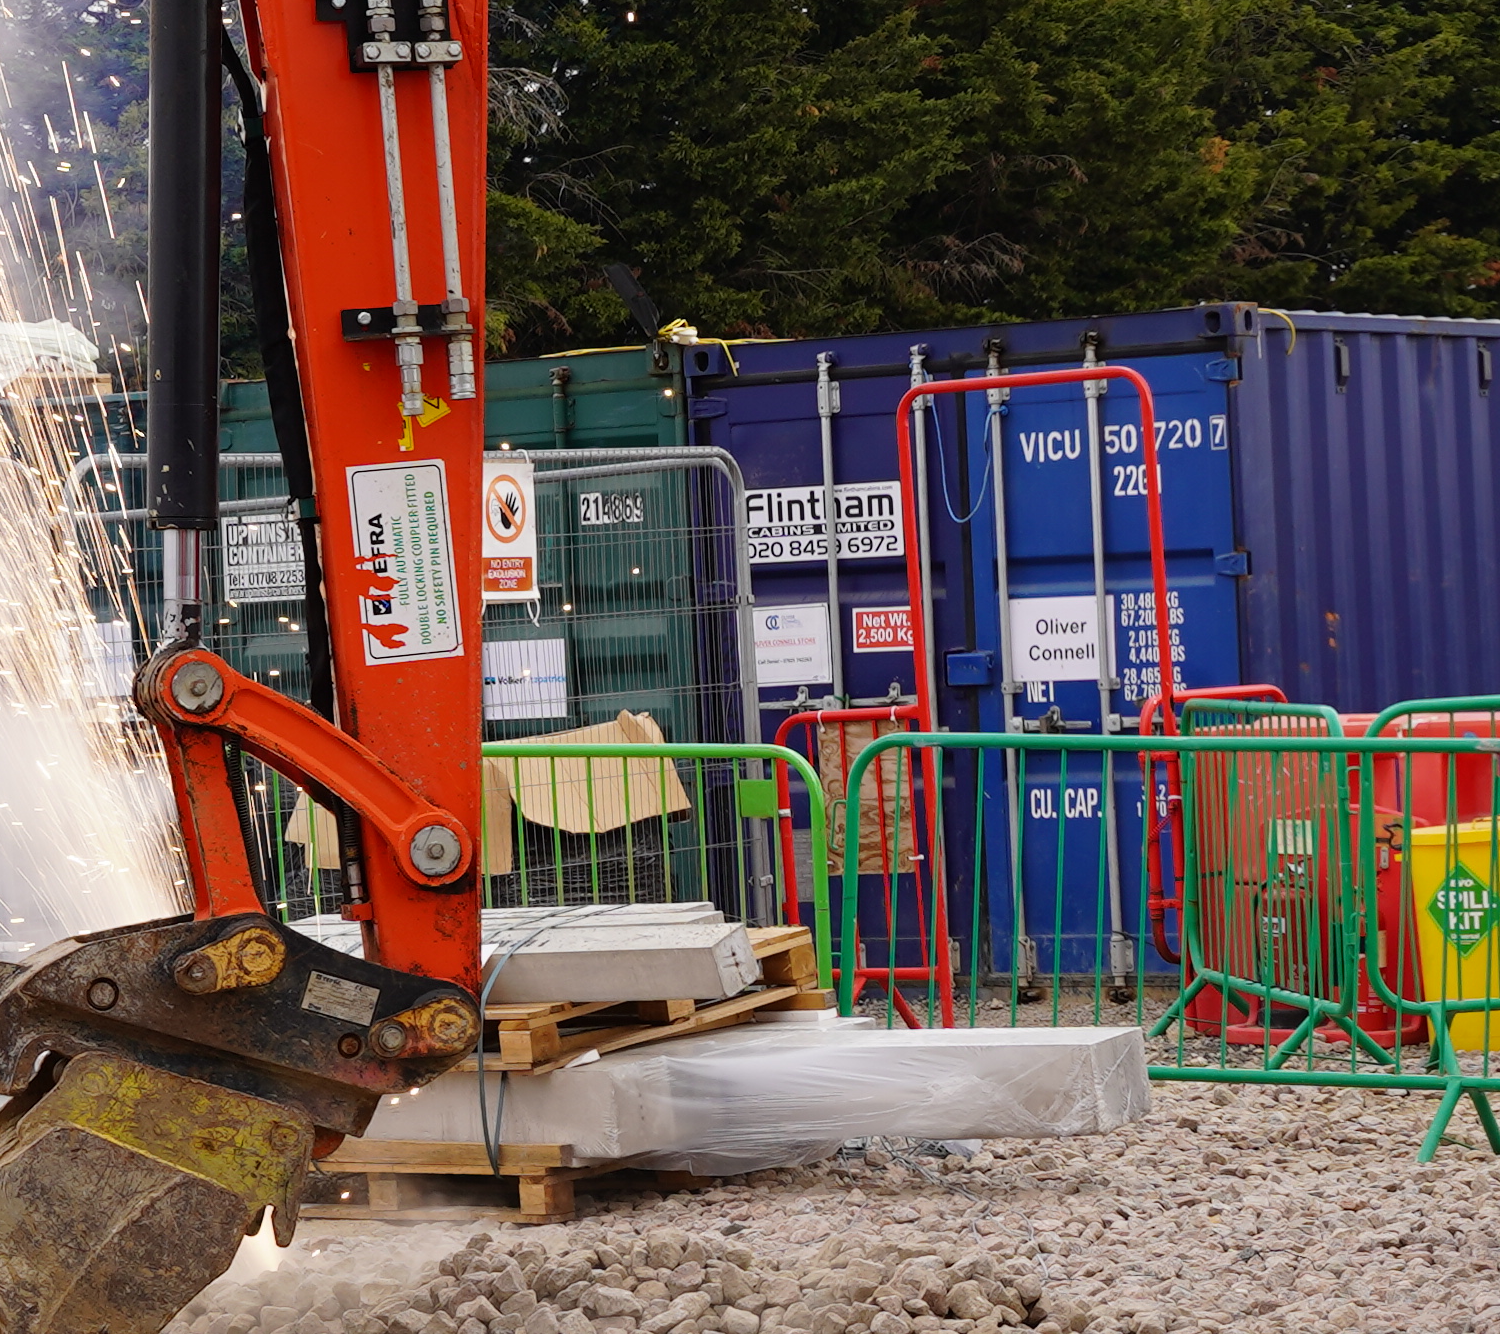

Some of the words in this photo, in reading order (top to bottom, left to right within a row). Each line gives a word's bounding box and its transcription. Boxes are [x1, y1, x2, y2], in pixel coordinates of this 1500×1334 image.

[1020, 429, 1081, 462] VICU
[1104, 418, 1201, 454] 50720
[1211, 418, 1225, 444] 7
[405, 474, 419, 509] FITTED
[423, 491, 439, 545] REQUIRED
[581, 493, 644, 522] 214869
[227, 522, 302, 545] UPMINSTE
[408, 510, 423, 558] COUPLER
[748, 524, 814, 538] CABINS
[390, 516, 405, 574] AUTOMATIC
[847, 535, 898, 553] 6972
[428, 545, 440, 566] PIN
[490, 559, 500, 568] NO
[501, 559, 524, 568] ENTRY
[228, 573, 245, 586] Tel:
[248, 571, 277, 585] 01708
[413, 558, 428, 602] LOCKING
[488, 569, 526, 579] EXCLUSION
[499, 579, 518, 589] ZONE
[395, 576, 410, 606] FULLY
[431, 570, 445, 609] SAFETY
[416, 603, 432, 645] DOUBLE
[436, 609, 448, 624] NO
[863, 613, 885, 627] Net
[889, 611, 911, 626] Wt.
[1036, 618, 1087, 635] Oliver
[1168, 608, 1184, 625] BS
[858, 628, 893, 644] 2,500
[1029, 643, 1095, 661] Connell
[1171, 645, 1186, 662] BS
[1027, 680, 1055, 703] NET
[1031, 789, 1057, 818] CU.
[1065, 788, 1103, 818] CAP.
